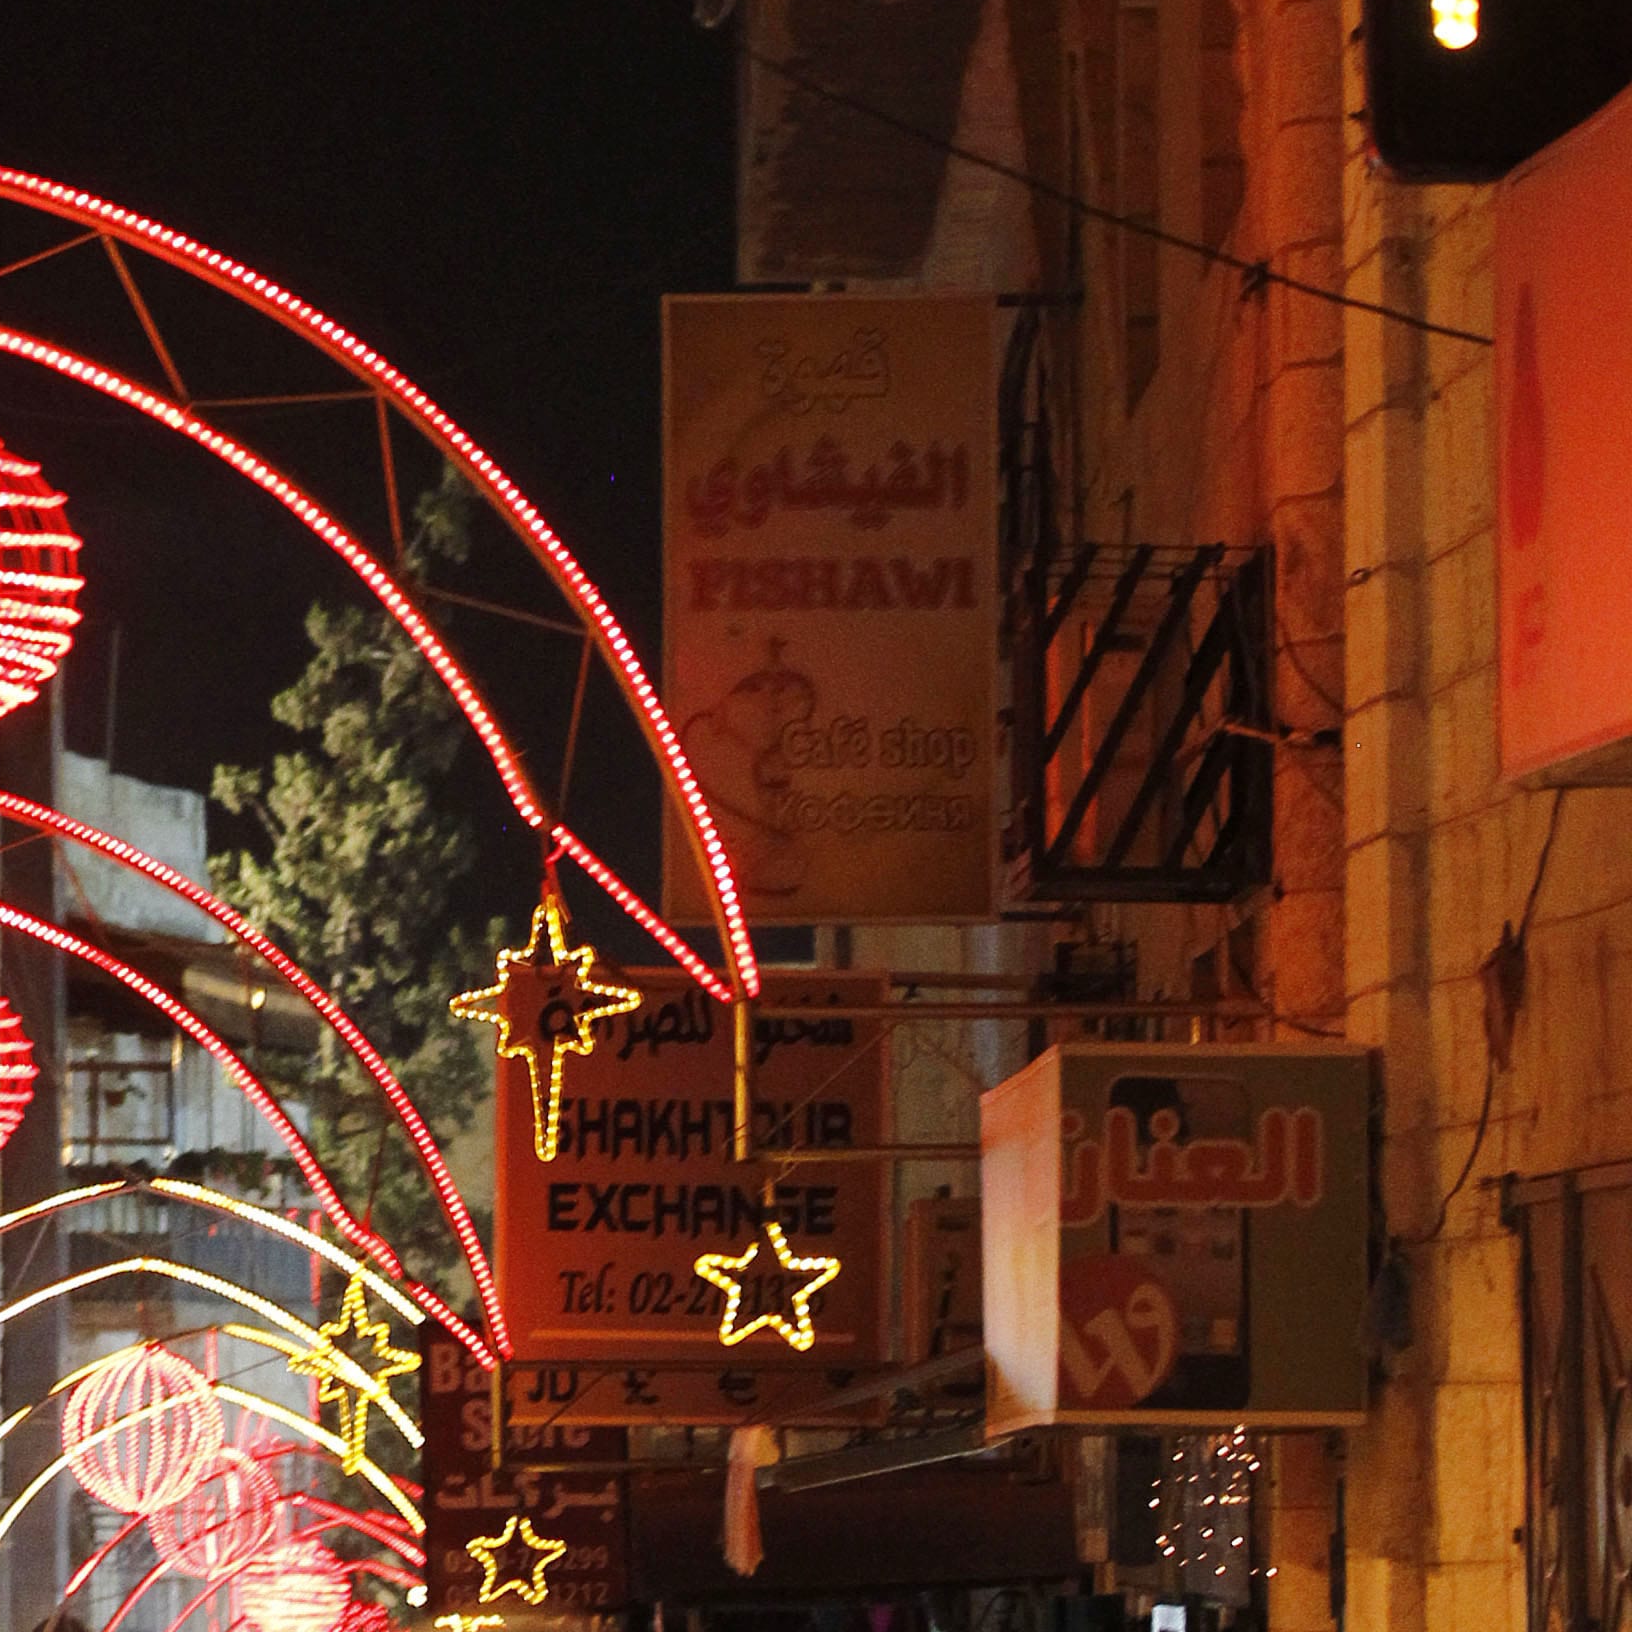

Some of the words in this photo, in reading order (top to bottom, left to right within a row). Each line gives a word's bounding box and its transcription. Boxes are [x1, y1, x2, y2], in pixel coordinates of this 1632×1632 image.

[685, 432, 970, 539] الفيشاوي
[687, 556, 979, 611] FISHAWI
[780, 714, 872, 769] Café
[877, 715, 977, 780] shop
[548, 1182, 839, 1239] EXCHANGE
[559, 1262, 615, 1315] Tel:
